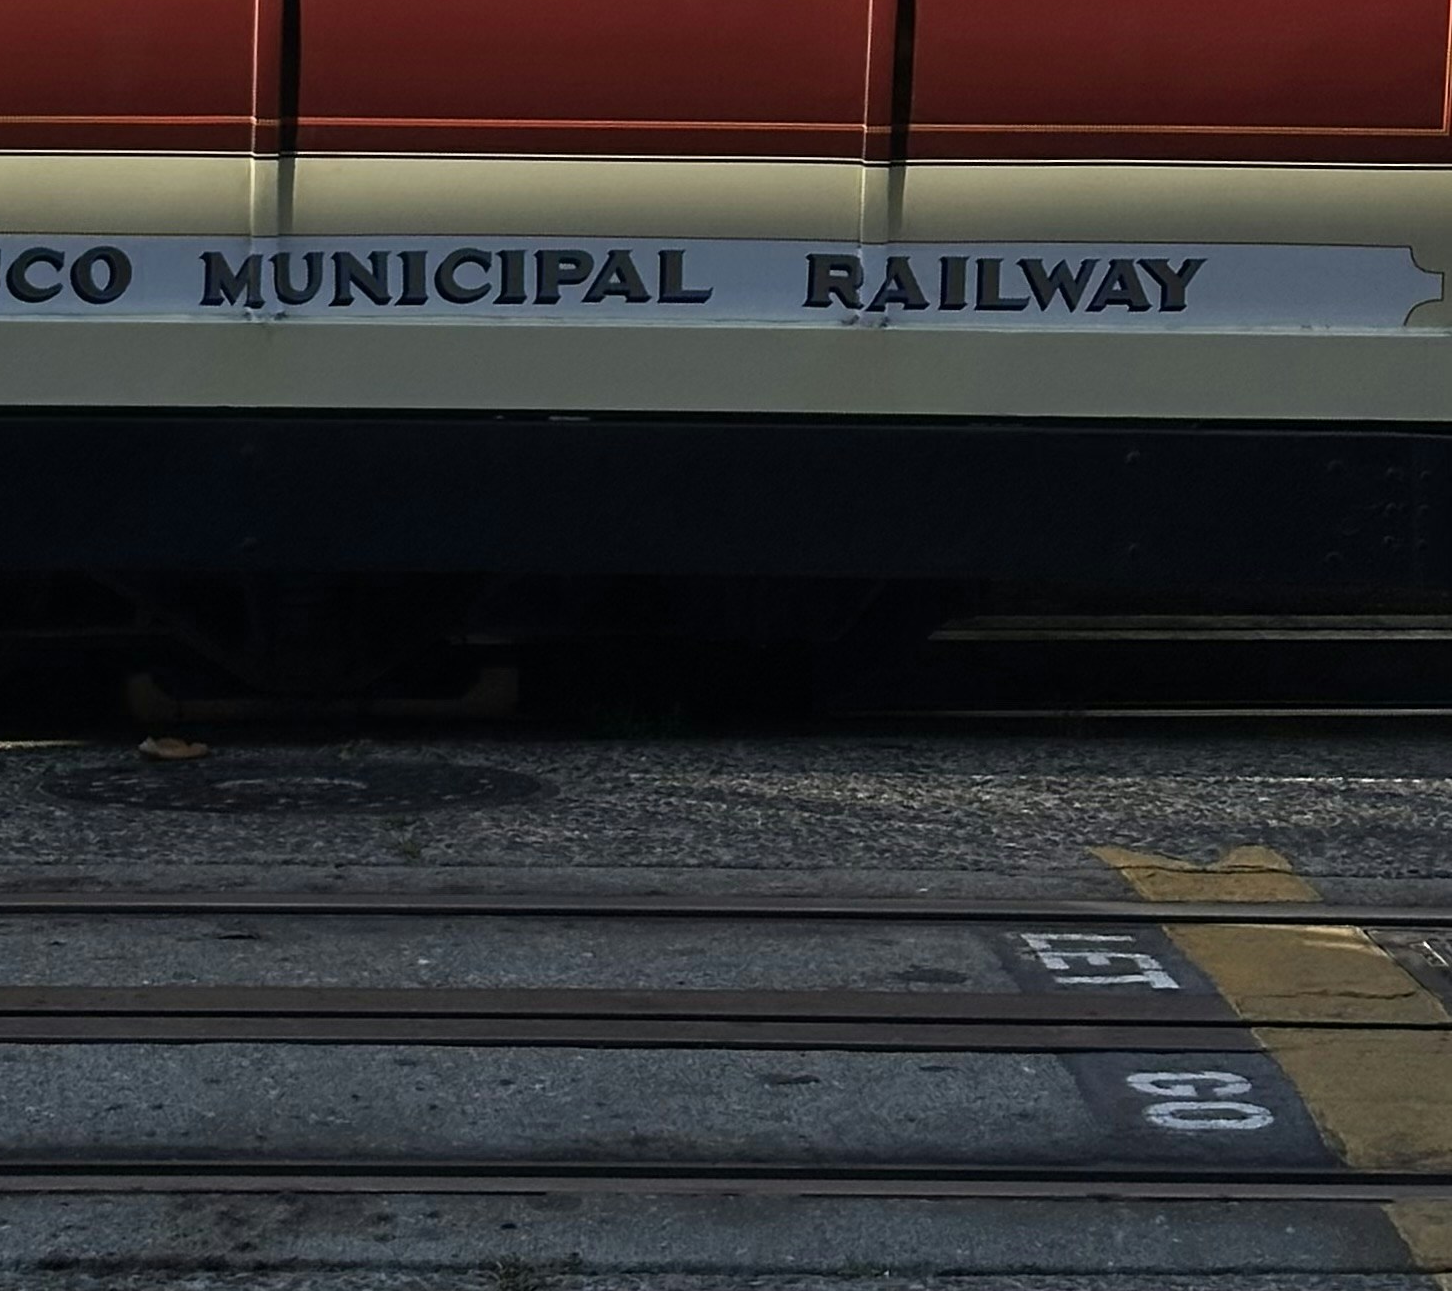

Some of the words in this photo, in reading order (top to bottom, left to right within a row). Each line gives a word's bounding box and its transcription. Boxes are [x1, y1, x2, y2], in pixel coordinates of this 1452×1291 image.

[199, 248, 712, 308] MUNICIPAL
[803, 252, 1207, 314] RAILWAY
[1018, 932, 1180, 990] LET
[1125, 1070, 1275, 1131] GO
